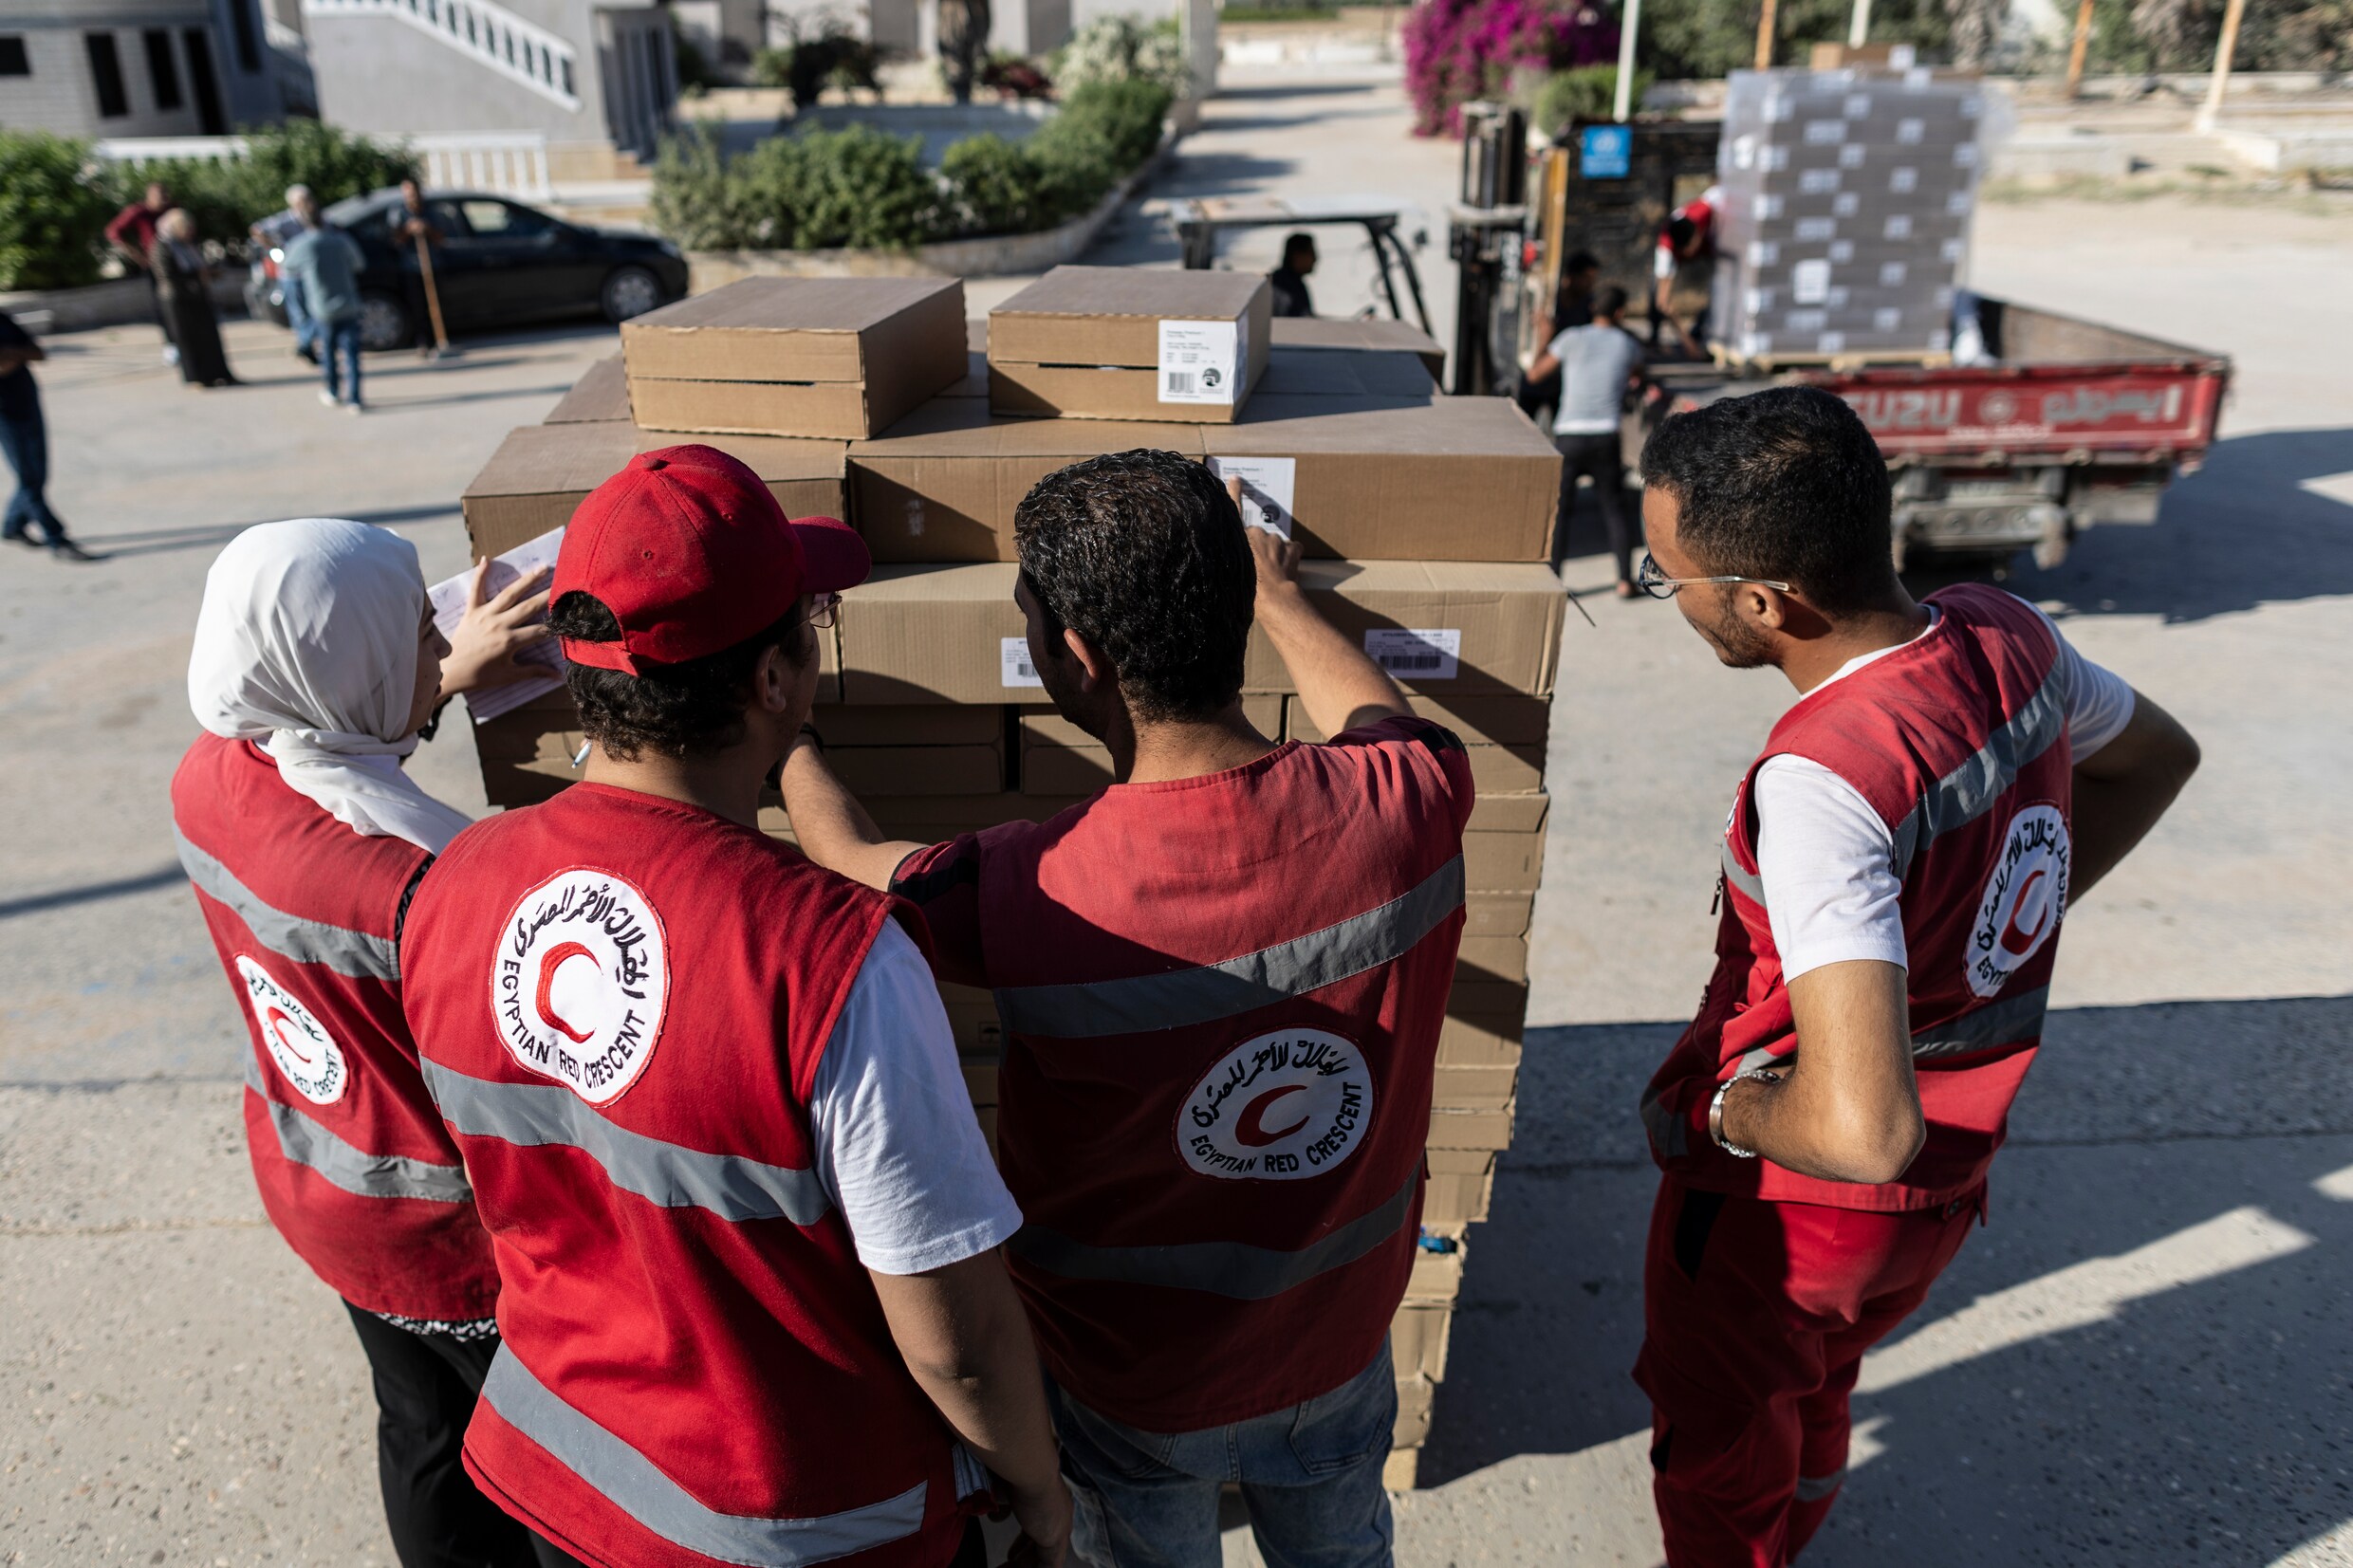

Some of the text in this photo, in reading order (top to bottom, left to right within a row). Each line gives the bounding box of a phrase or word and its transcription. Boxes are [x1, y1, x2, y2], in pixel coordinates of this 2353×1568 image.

[603, 906, 649, 1000] الهلال
[502, 959, 646, 1090] EGYPTIAN RED CRESCENT
[1291, 1040, 1351, 1077] الهلال
[1190, 1081, 1362, 1173] EGYPTIAN RED CRESCENT
